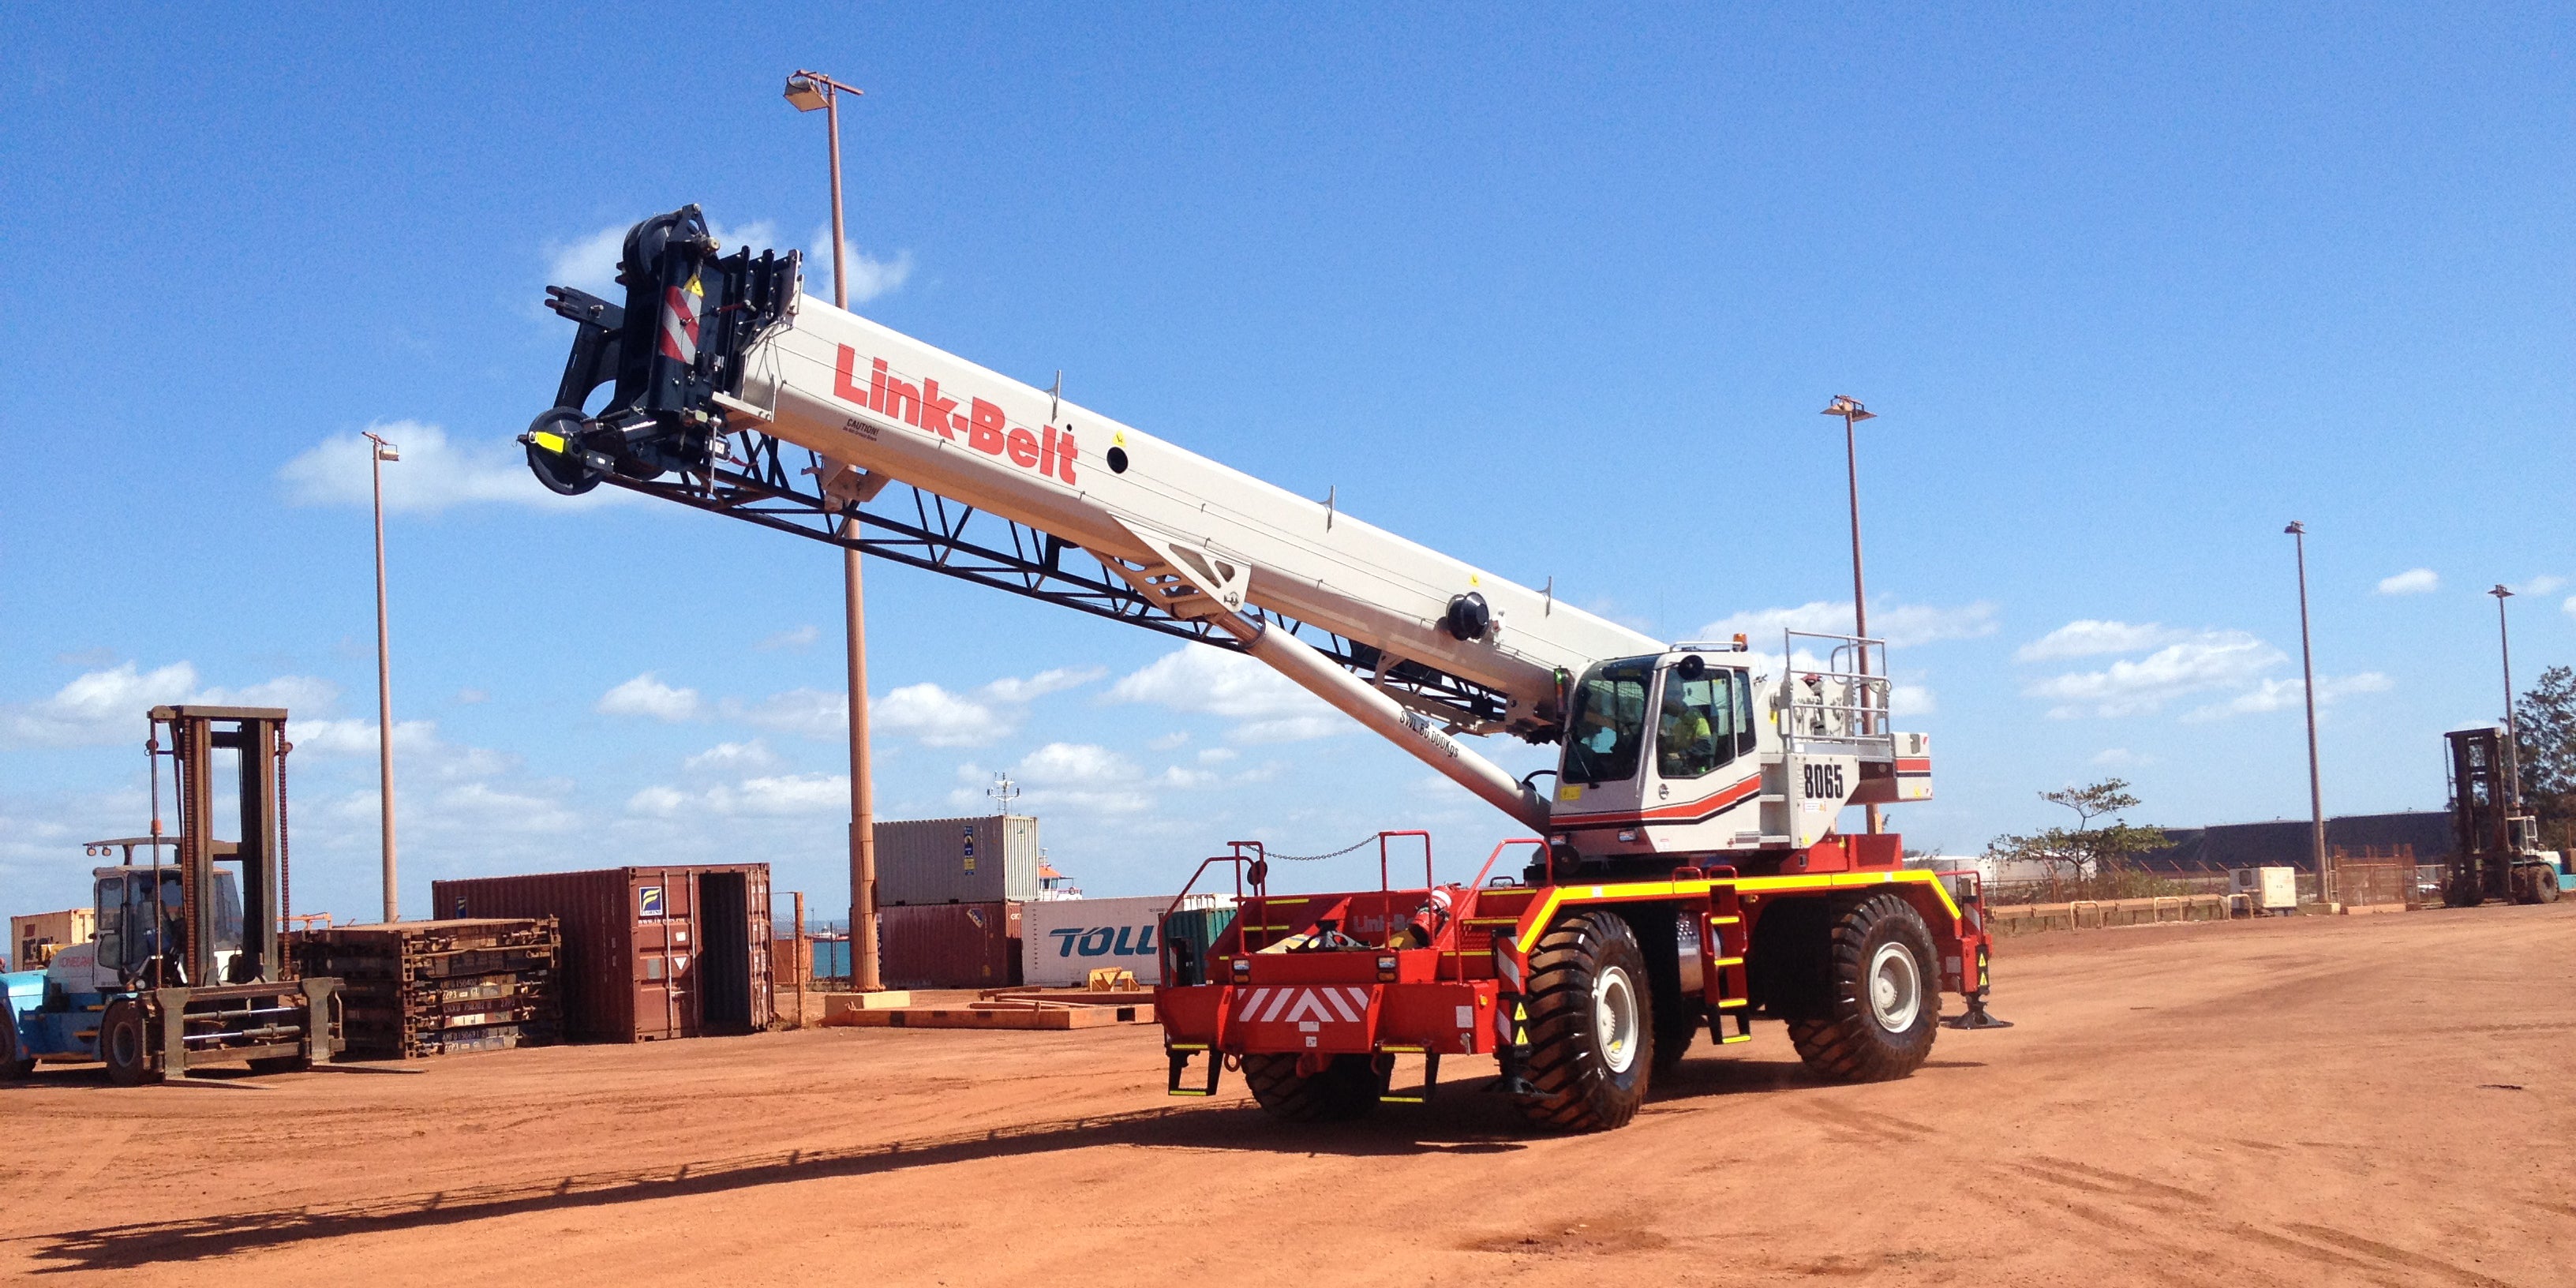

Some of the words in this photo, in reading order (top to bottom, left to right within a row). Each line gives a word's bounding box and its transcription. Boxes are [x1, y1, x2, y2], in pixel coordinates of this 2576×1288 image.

[833, 343, 1078, 485] Link-Belt
[847, 418, 880, 436] CAUTION!
[1804, 764, 1844, 799] 8065
[1049, 925, 1158, 958] TOLL
